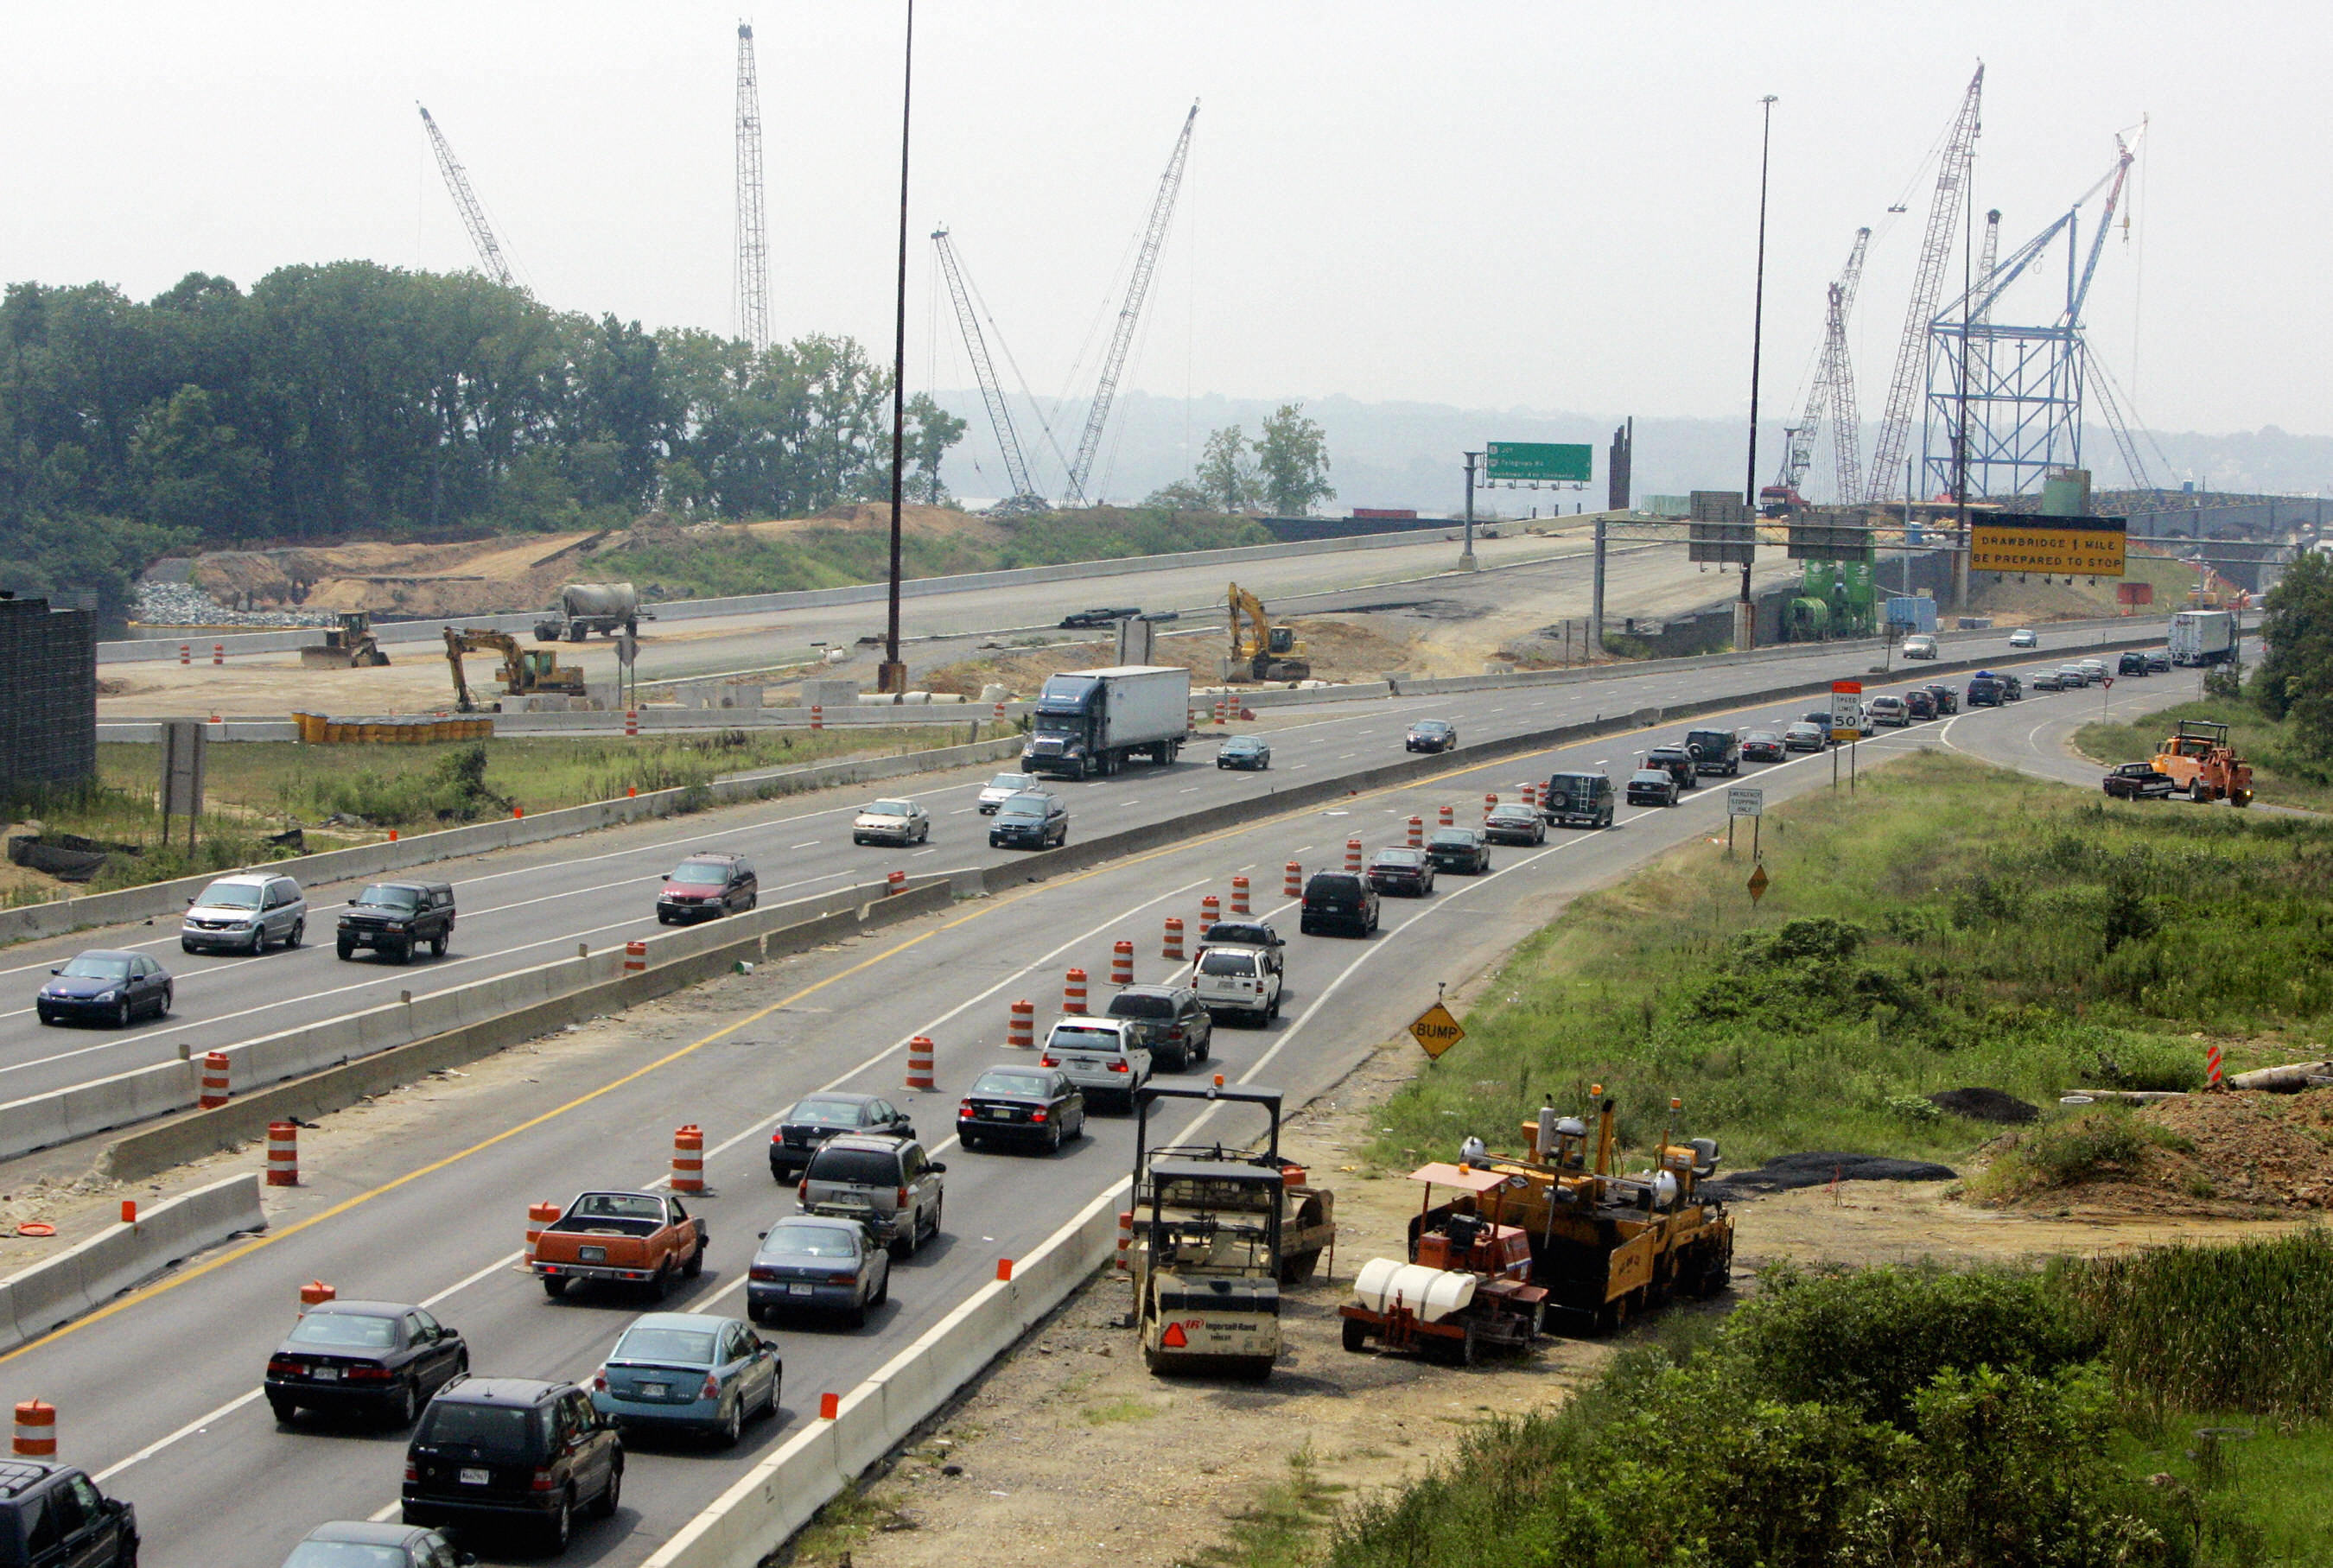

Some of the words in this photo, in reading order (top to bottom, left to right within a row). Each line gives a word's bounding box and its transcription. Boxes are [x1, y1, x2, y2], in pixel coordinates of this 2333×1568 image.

[1981, 536, 2065, 549] DRAWBRIDGE
[2085, 541, 2115, 550] MILE
[1973, 553, 1989, 563] BE
[1994, 554, 2062, 566] PREPARED
[2068, 556, 2082, 567] TO
[2088, 557, 2122, 568] STOP
[1834, 715, 1856, 727] 50
[1416, 1023, 1458, 1039] BUMP
